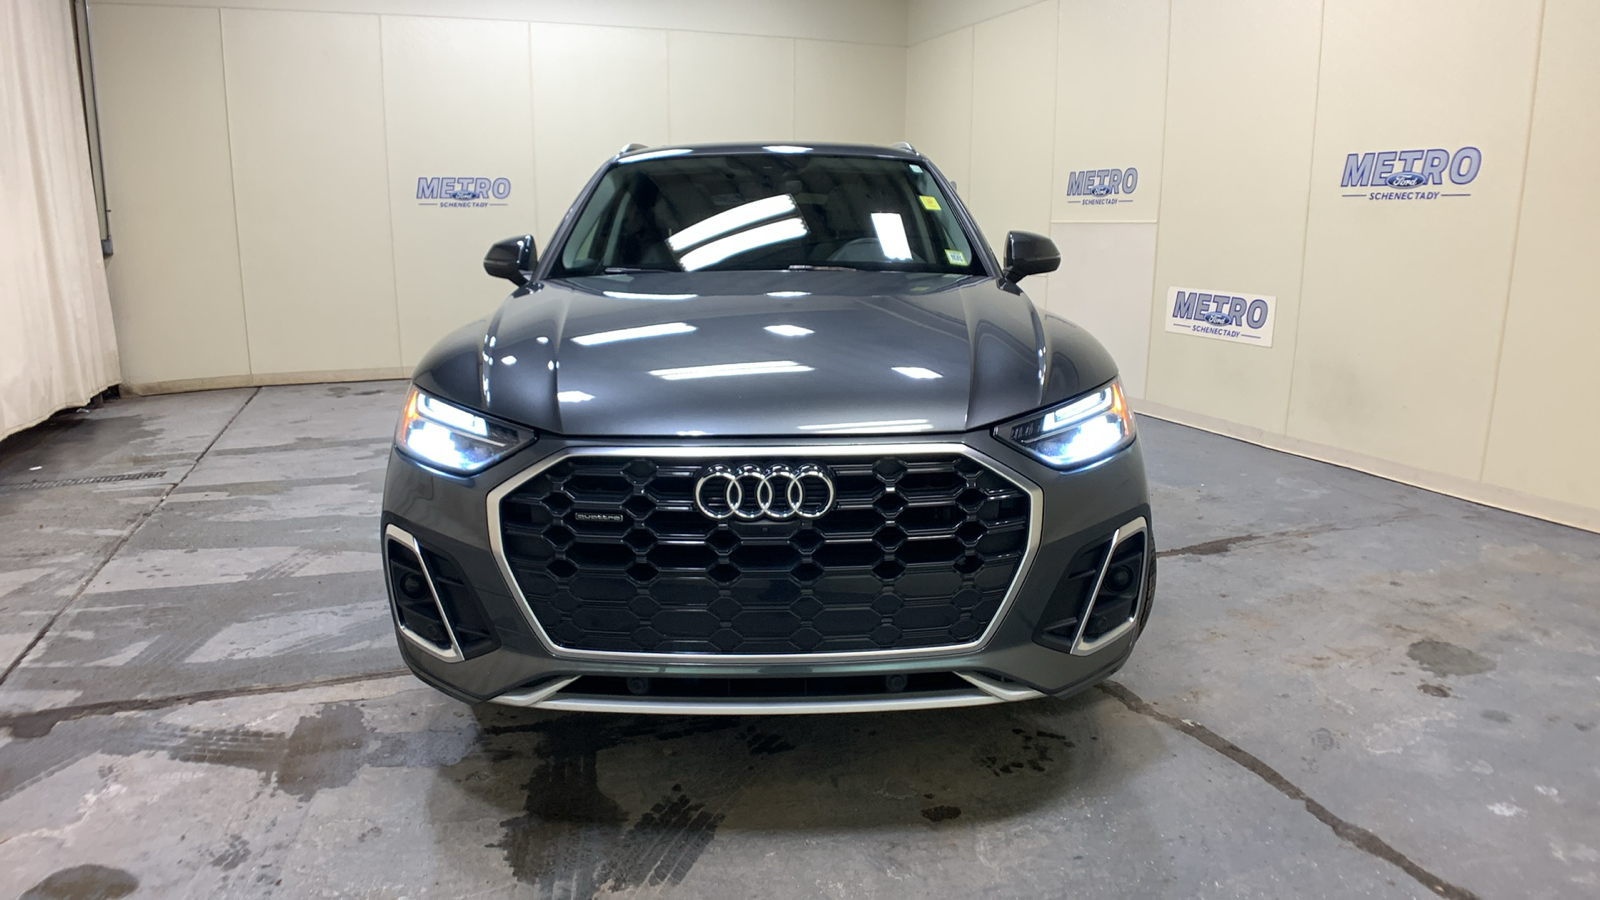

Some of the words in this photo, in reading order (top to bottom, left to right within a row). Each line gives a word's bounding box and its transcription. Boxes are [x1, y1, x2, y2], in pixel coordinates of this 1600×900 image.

[1340, 146, 1482, 187] METRO
[416, 177, 511, 199] METRO
[1066, 167, 1138, 196] METRO
[1392, 174, 1418, 187] Ford
[1369, 191, 1440, 200] SCHENECTADY
[1172, 291, 1268, 329] METRO
[1192, 325, 1240, 338] SCHENECTADY
